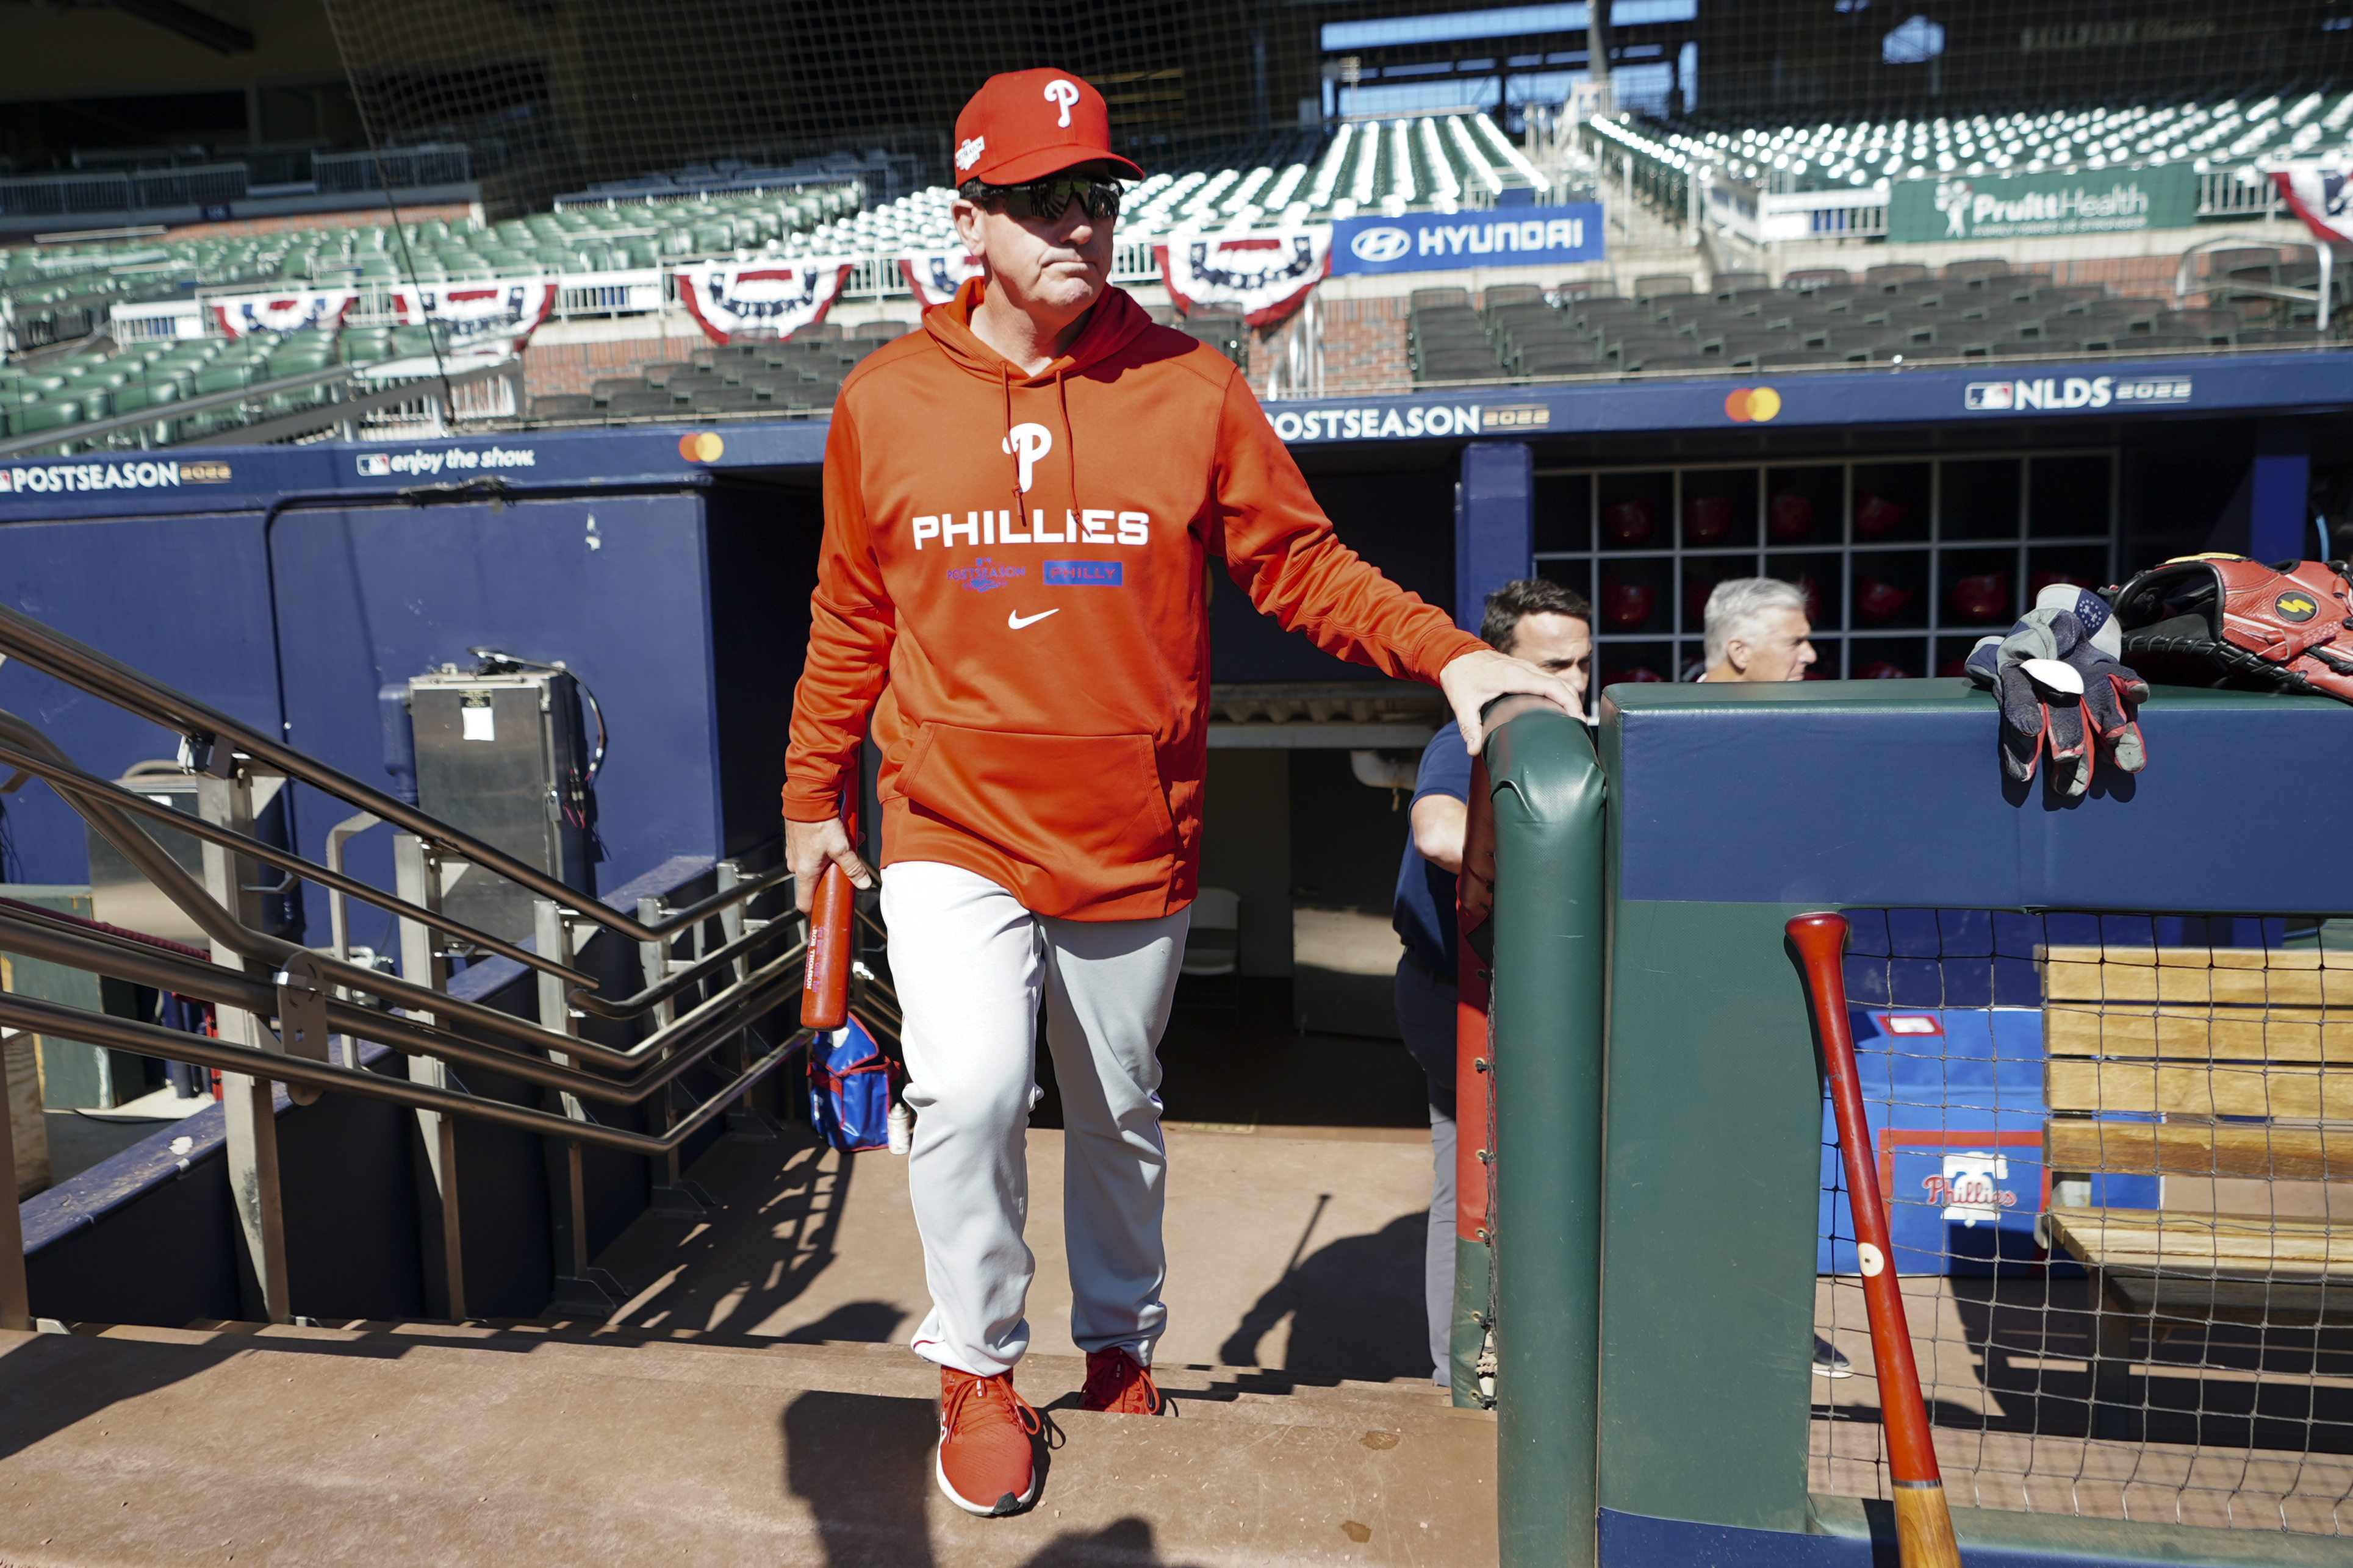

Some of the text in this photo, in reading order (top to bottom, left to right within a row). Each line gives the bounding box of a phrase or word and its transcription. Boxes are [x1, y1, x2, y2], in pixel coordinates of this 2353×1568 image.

[1044, 79, 1079, 128] P
[1972, 182, 2148, 223] PruittHealth
[1418, 218, 1584, 257] HYUNDAI
[2014, 376, 2193, 410] NLDS 2022
[1482, 408, 1550, 428] 2022
[390, 449, 444, 476] enjoy
[445, 448, 480, 468] the
[1002, 423, 1052, 493] P
[12, 461, 232, 494] POSTSEASON 2022
[912, 509, 1149, 550] PHILLIES
[947, 566, 1026, 581] POSTSEASON
[1050, 567, 1116, 579] PHILLY
[806, 949, 816, 989] THOMSON
[1922, 1174, 2017, 1207] Phillies
